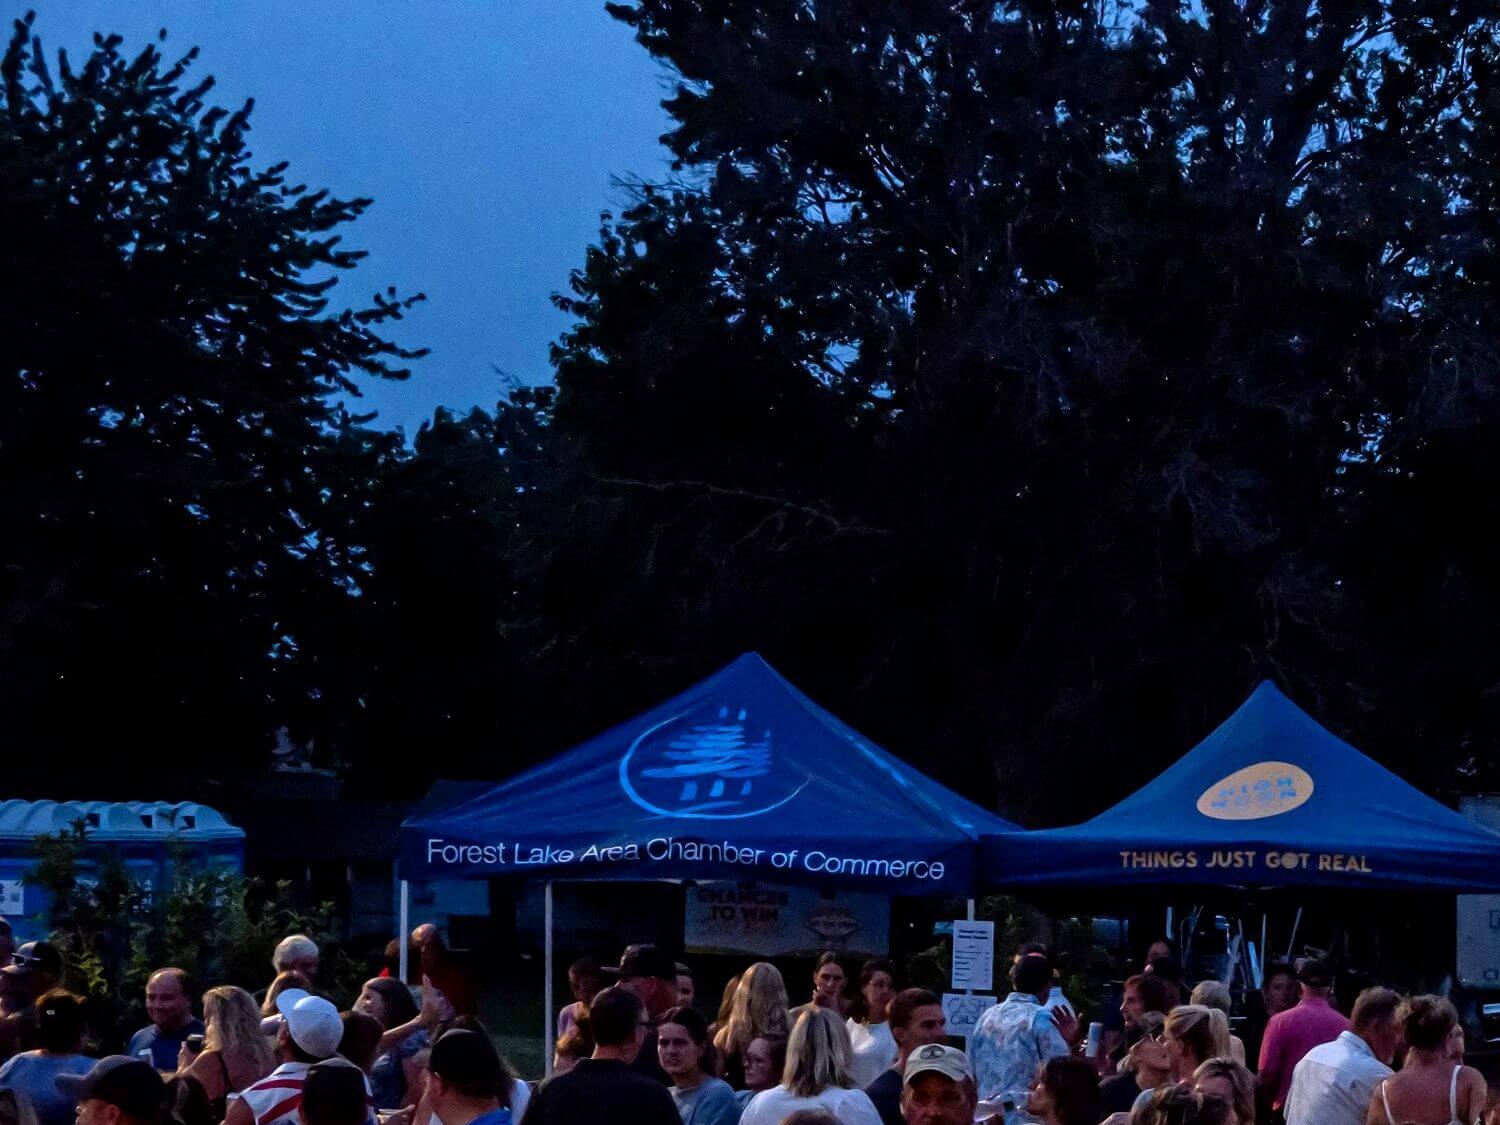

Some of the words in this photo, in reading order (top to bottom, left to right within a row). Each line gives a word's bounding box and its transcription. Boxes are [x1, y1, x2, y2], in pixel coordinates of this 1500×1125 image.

[427, 838, 506, 865] Forest
[514, 842, 574, 865] Lake
[580, 840, 640, 863] Area
[646, 837, 766, 866] Chamber
[771, 849, 799, 869] of
[803, 850, 945, 880] Commerce
[1119, 850, 1198, 869] THINGS
[1205, 850, 1256, 869] JUST
[1265, 852, 1311, 870] GOT
[1318, 853, 1373, 874] REAL
[711, 906, 736, 921] TO
[741, 906, 779, 921] WIN
